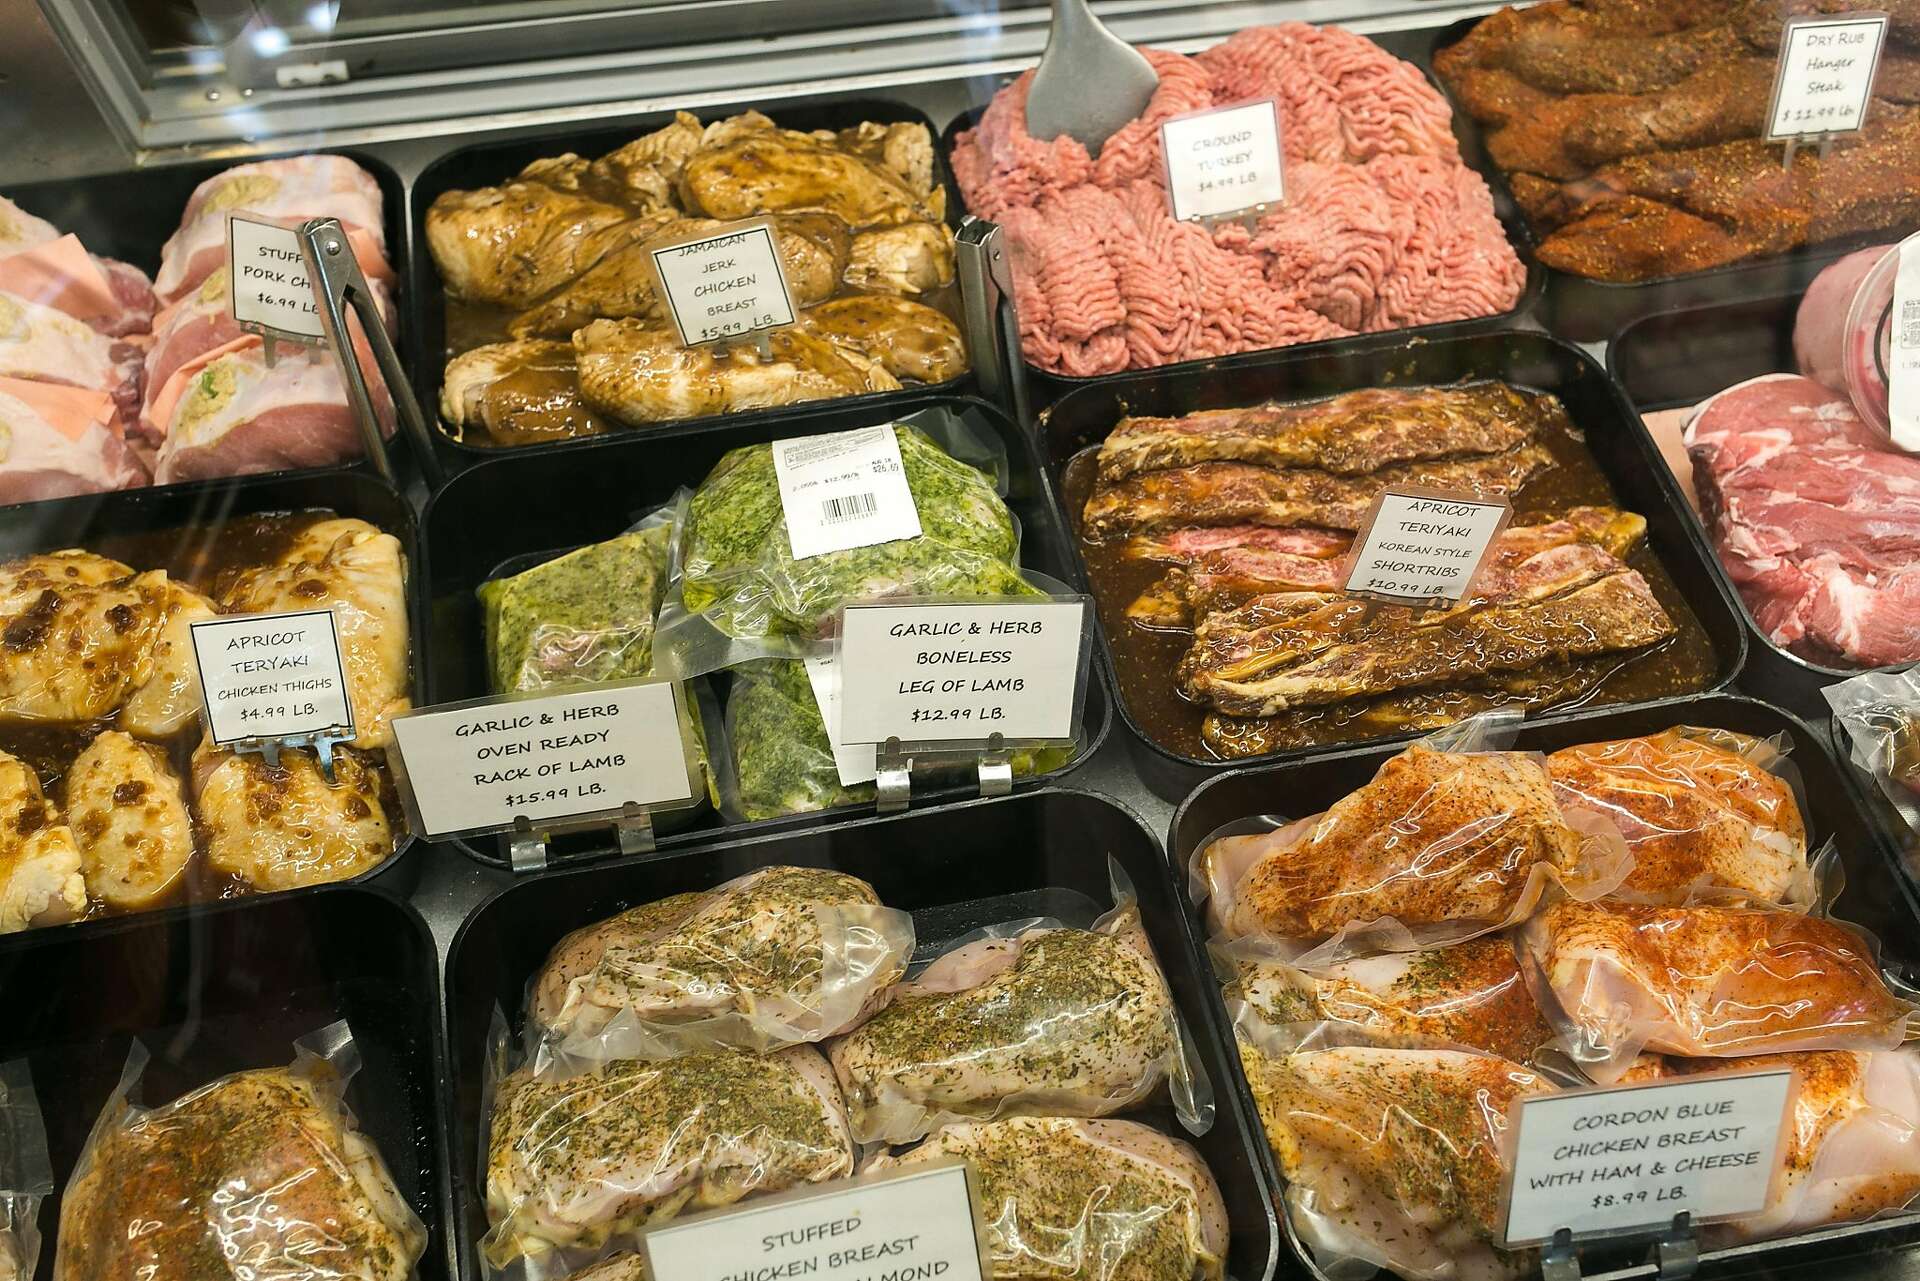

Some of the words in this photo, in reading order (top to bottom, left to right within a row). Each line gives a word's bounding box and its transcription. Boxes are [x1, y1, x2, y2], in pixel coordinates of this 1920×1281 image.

[1806, 34, 1835, 47] DRY
[1839, 32, 1865, 44] RUB
[1806, 57, 1855, 72] Hanger
[1806, 81, 1843, 95] Steak
[259, 247, 303, 263] STUFF
[679, 234, 746, 257] JAMAICAN
[244, 266, 286, 283] PORK
[702, 258, 736, 274] JERK
[694, 274, 756, 297] CHICKEN
[257, 292, 296, 309] $6.99
[707, 297, 757, 317] BREAST
[1407, 501, 1481, 517] APRICOT
[1399, 521, 1472, 537] TERIYAKI
[1378, 541, 1432, 555] KOREAN
[1433, 547, 1473, 558] STYLE
[1371, 559, 1461, 578] SHORTRIBS
[1367, 578, 1419, 593] $10.99
[890, 622, 963, 637] GARLIC
[968, 622, 982, 635] &
[989, 621, 1043, 635] HERB
[226, 631, 306, 651] APRICOT
[231, 655, 308, 674] TERYAKI
[916, 650, 1012, 665] BONELESS
[217, 683, 278, 701] CHICKEN
[282, 678, 332, 692] THIGHS
[899, 680, 935, 694] LEG
[941, 680, 966, 692] OF
[971, 678, 1025, 692] LAMB
[240, 706, 285, 721] $4.99
[293, 703, 318, 717] LB.
[455, 715, 533, 737] GARLIC
[540, 713, 554, 725] &
[563, 704, 620, 722] HERB
[911, 707, 972, 722] $12.99
[979, 707, 1006, 720] LB.
[477, 741, 531, 760] OVEN
[539, 729, 611, 751] READY
[473, 767, 532, 786] RACK
[537, 763, 562, 777] OF
[569, 754, 626, 774] LAMB
[505, 787, 569, 807] $15.99
[578, 782, 607, 797] LB.
[1573, 1106, 1669, 1132] CORDON
[1677, 1100, 1735, 1117] BLUE
[1553, 1136, 1650, 1161] CHICKEN
[1657, 1126, 1746, 1147] BREAST
[1530, 1171, 1584, 1190] WITH
[1591, 1164, 1642, 1181] HAM
[1650, 1162, 1667, 1176] &
[1675, 1151, 1761, 1173] CHEESE
[1590, 1191, 1648, 1209] $8.99
[1657, 1186, 1687, 1201] LB.
[762, 1217, 862, 1252] STUFFED
[720, 1256, 818, 1281] HICKEN
[828, 1235, 920, 1268] BREAST
[856, 1260, 950, 1281] MOND
